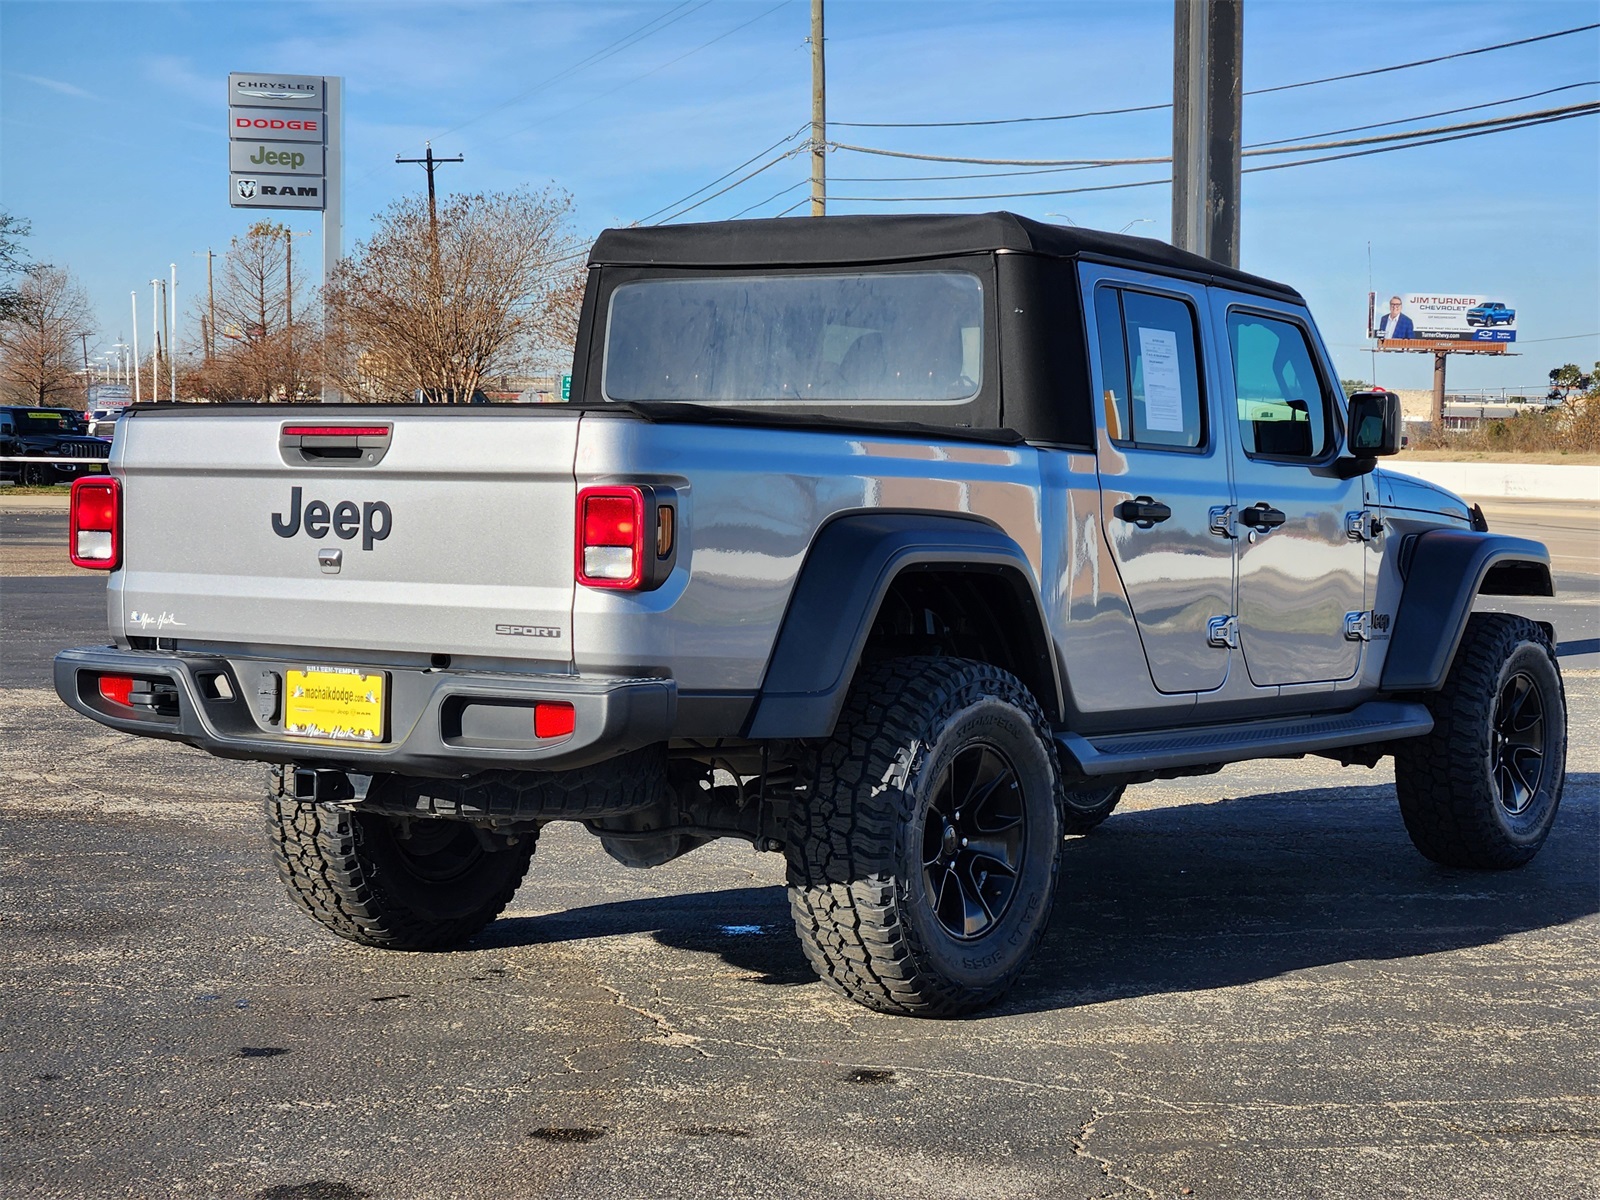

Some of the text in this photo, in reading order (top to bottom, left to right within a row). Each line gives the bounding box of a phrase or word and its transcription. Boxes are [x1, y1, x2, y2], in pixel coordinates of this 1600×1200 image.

[237, 81, 315, 91] CHRYSLER
[236, 118, 317, 131] DODGE
[250, 145, 305, 170] Jeep
[261, 186, 318, 197] RAM
[1410, 296, 1477, 306] JIM TURNER
[1419, 304, 1467, 312] CHEVROLET
[1421, 331, 1460, 339] TurnerChevy.com
[271, 486, 393, 551] Jeep
[495, 624, 561, 638] SPORT
[306, 665, 360, 675] KILLEEN-TEMPLE
[304, 686, 364, 705] machaikdodge.com
